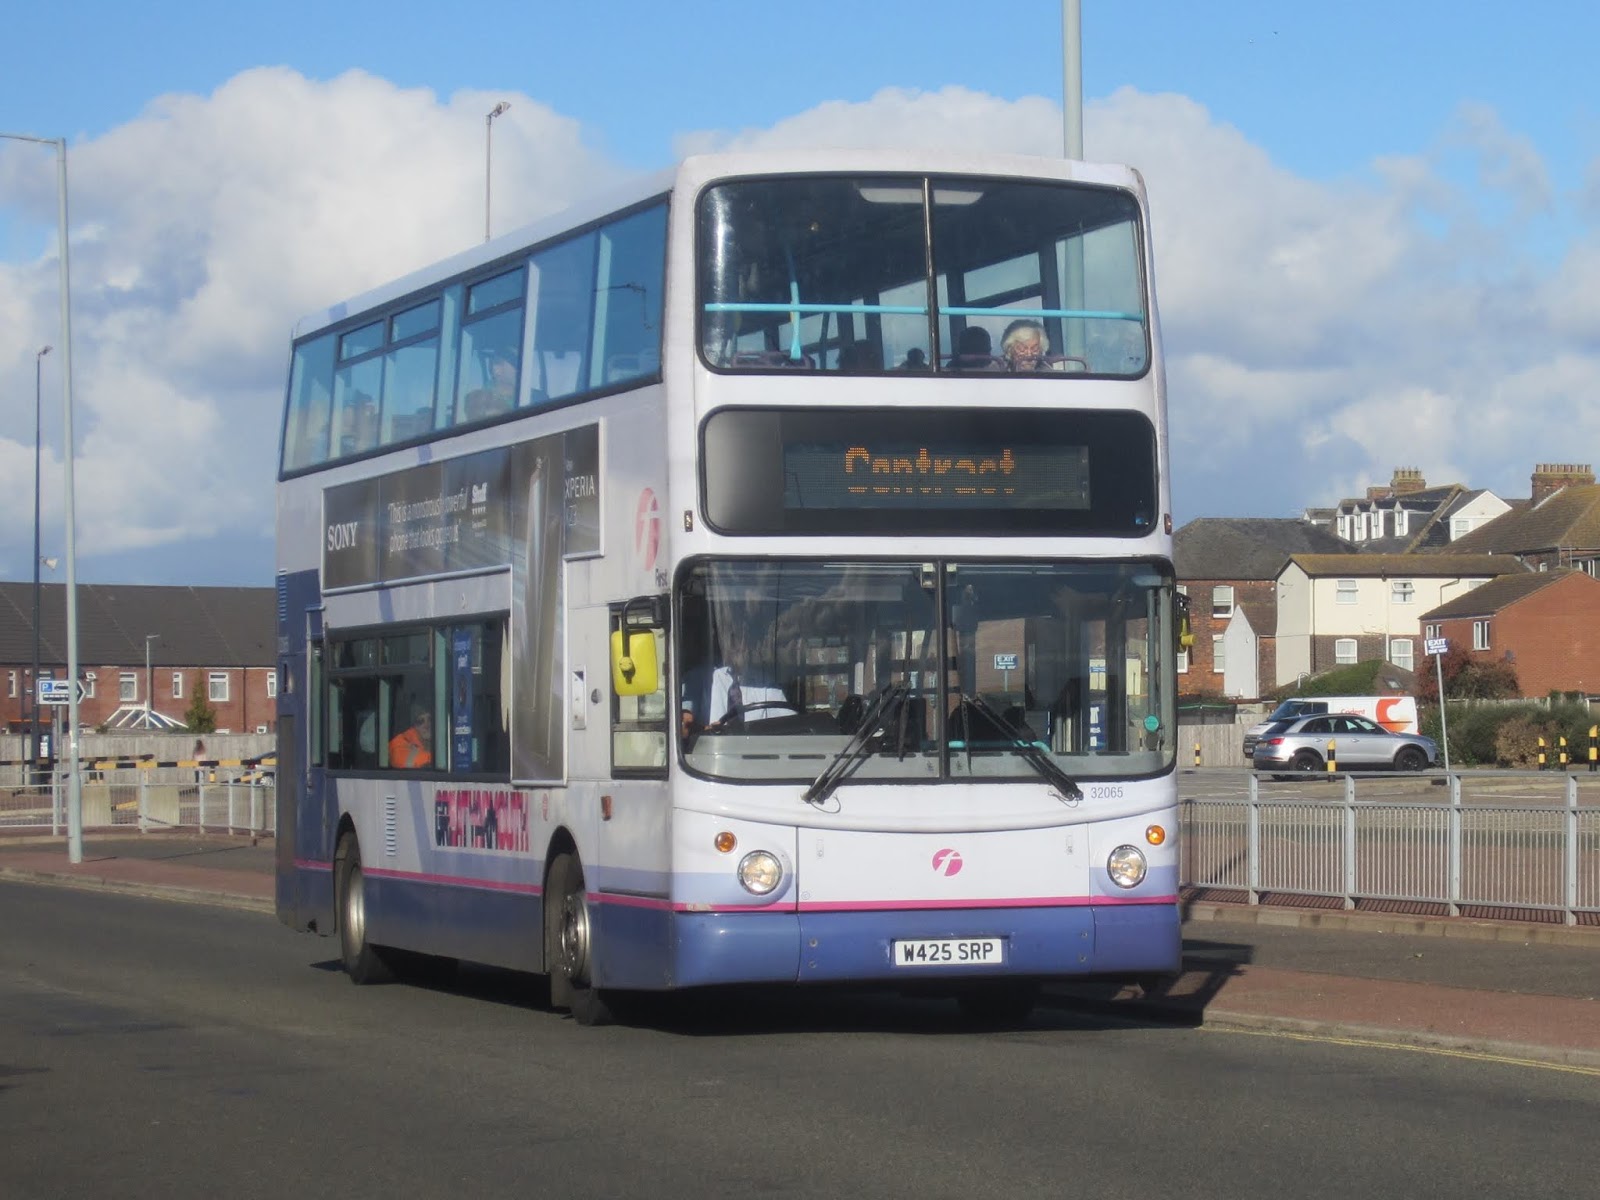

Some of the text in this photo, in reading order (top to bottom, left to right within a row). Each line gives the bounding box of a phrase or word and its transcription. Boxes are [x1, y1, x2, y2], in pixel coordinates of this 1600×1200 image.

[845, 446, 1016, 494] Contract
[565, 474, 595, 499] XPERIA
[327, 521, 358, 551] SONY
[1428, 638, 1446, 647] EXIT
[42, 683, 49, 691] P
[1090, 787, 1123, 799] 32065
[903, 942, 994, 962] W425 SRP
